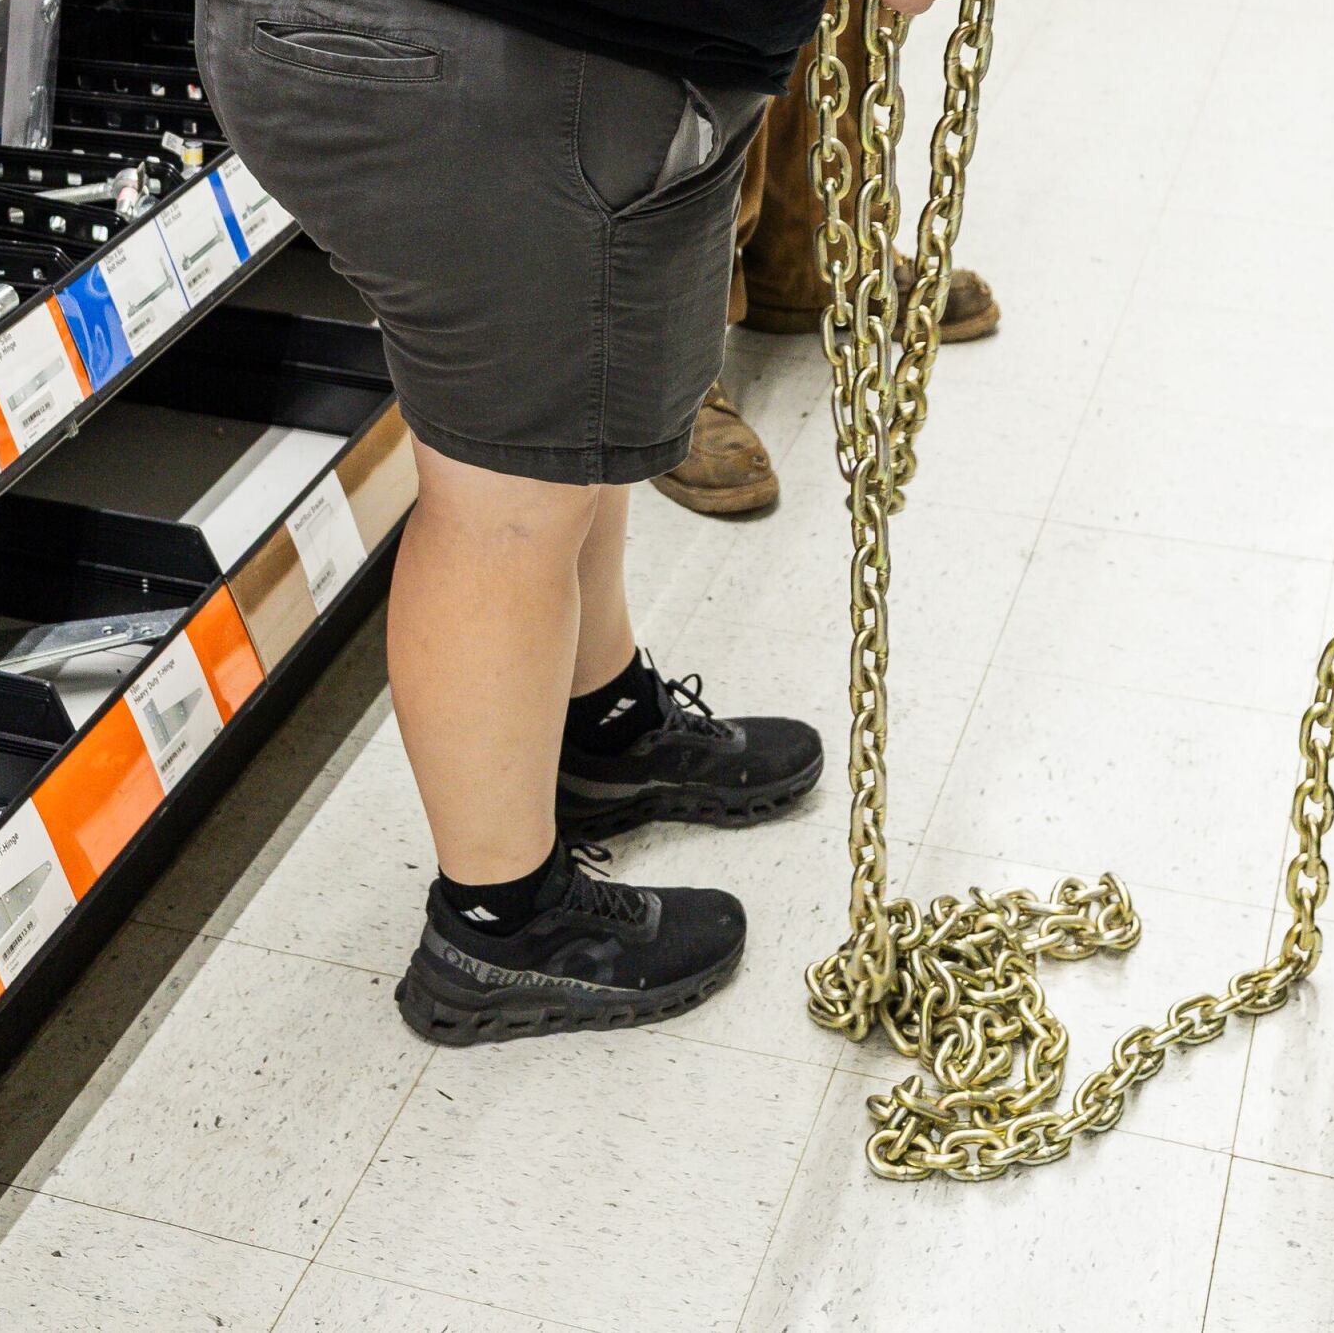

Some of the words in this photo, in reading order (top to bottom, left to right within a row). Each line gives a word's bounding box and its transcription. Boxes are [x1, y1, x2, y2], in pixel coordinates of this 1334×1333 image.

[133, 686, 150, 708] Heavy
[148, 673, 162, 692] Duty
[158, 657, 176, 680] T-Hinge
[0, 831, 20, 855] T-Hinge
[19, 919, 36, 942] $13.99
